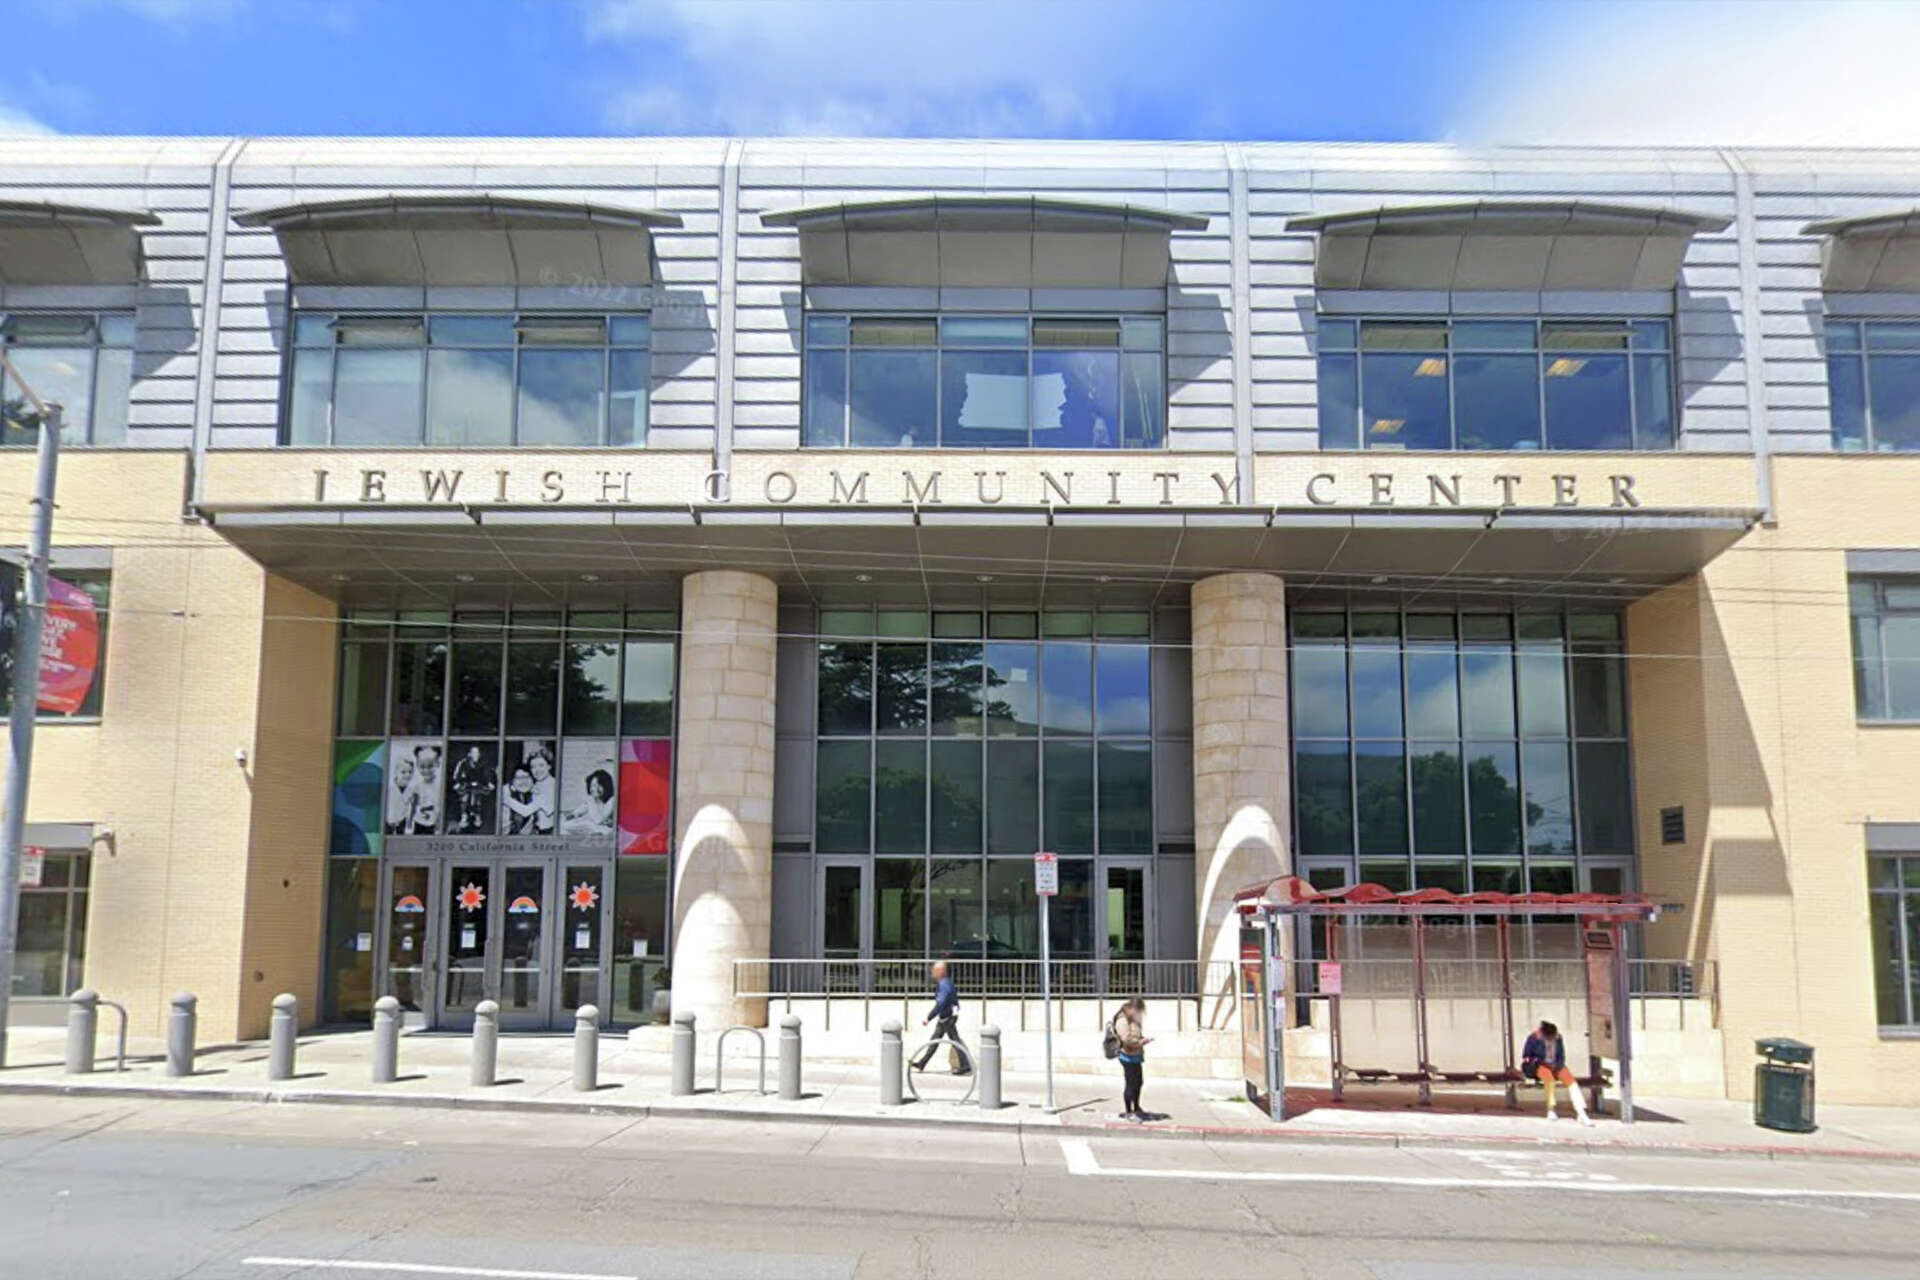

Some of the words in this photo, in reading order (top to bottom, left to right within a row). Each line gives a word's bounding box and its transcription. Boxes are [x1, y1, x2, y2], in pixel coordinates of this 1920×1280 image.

[704, 469, 1242, 505] COMMUNITY
[1306, 472, 1642, 508] CENTER
[459, 841, 525, 852] California
[531, 840, 570, 851] Street
